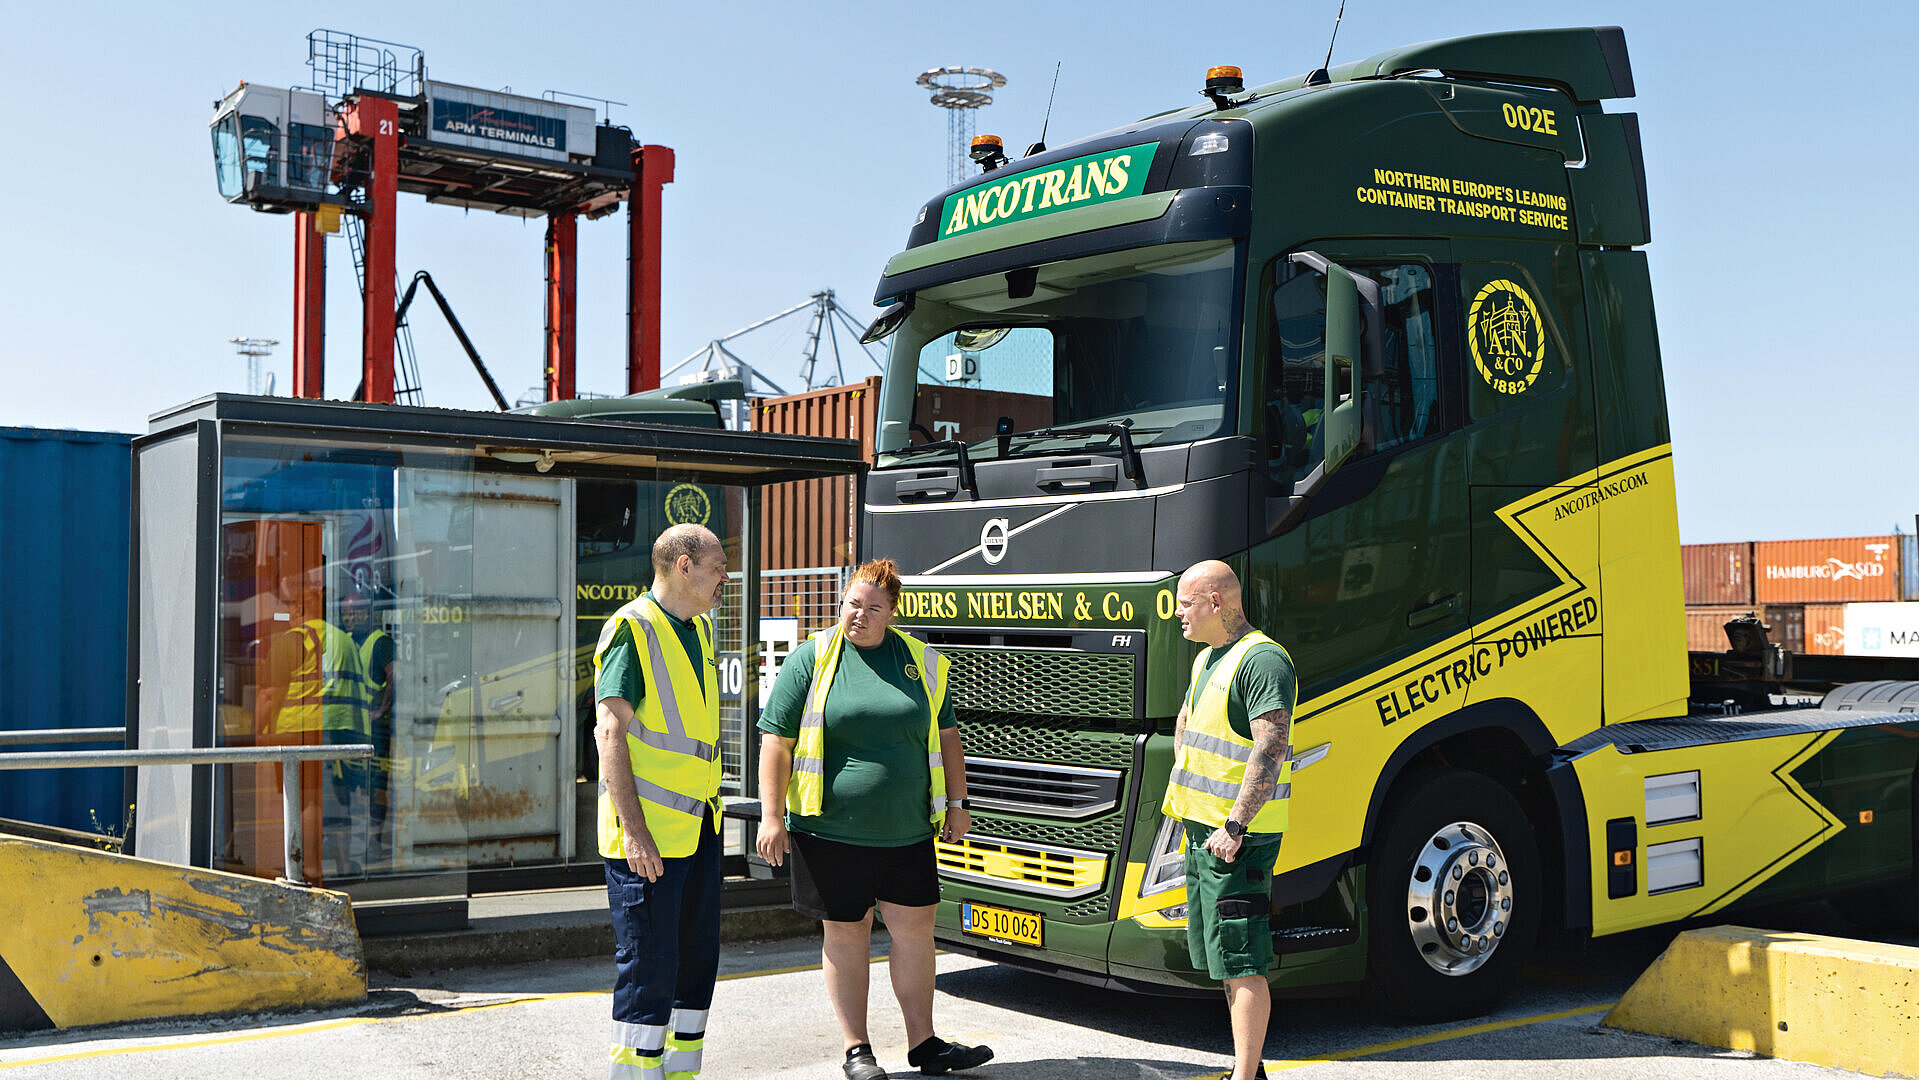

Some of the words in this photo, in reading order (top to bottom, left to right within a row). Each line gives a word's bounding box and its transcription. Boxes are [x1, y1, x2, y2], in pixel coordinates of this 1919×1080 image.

[379, 119, 393, 136] 21
[445, 119, 475, 134] APM
[479, 125, 556, 148] TERMINALS
[1502, 102, 1558, 135] 002E
[945, 154, 1131, 235] ANCOTRANS
[1374, 168, 1450, 193] NORTHERN
[1452, 179, 1513, 201] EUROPE'S
[1515, 188, 1567, 211] LEADING
[1356, 186, 1435, 212] CONTAINER
[1438, 196, 1516, 222] TRANSPORT
[1519, 208, 1568, 231] SERVICE
[965, 358, 977, 375] D
[1493, 378, 1527, 395] 1882
[1554, 472, 1648, 521] ANCOTRANS.COM
[1766, 564, 1831, 580] HAMBURG
[967, 591, 1064, 621] NIELSEN
[1073, 591, 1093, 621] &
[1102, 591, 1134, 622] Co
[1112, 634, 1131, 648] FH
[718, 657, 743, 695] 10
[1375, 648, 1492, 727] ELECTRIC
[1497, 596, 1598, 667] POWERED
[972, 908, 989, 930] DS
[994, 913, 1009, 934] 10
[1012, 916, 1038, 940] 062
